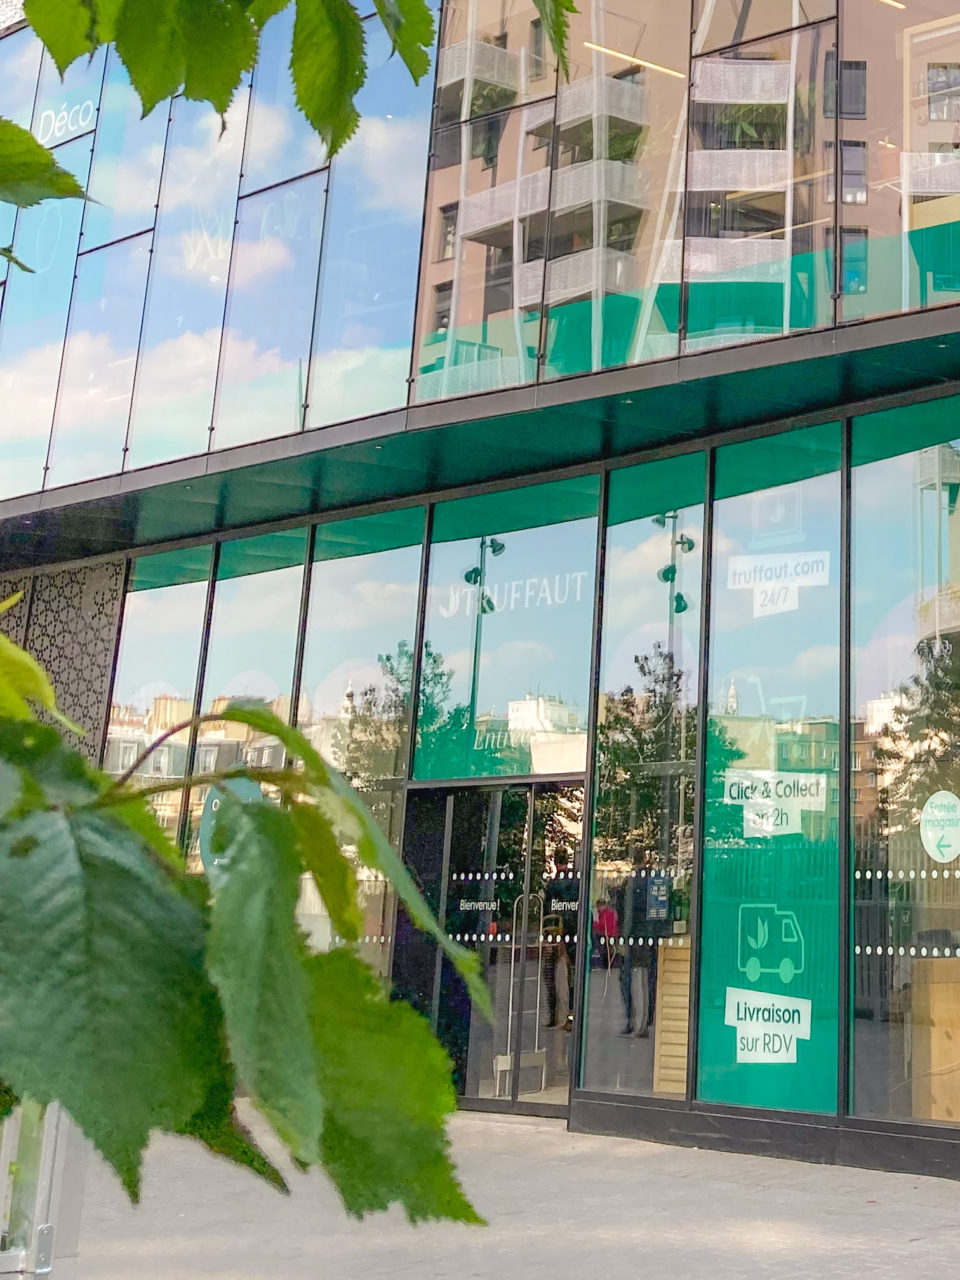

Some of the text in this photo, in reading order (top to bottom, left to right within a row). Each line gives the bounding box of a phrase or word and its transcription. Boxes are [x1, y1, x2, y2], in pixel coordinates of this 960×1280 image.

[38, 99, 94, 144] Déco
[731, 558, 825, 586] truffaut.com
[461, 571, 588, 616] TRUFFAUT
[759, 586, 790, 608] 24/7
[728, 778, 821, 800] Click & Collect
[772, 807, 789, 827] 2h
[736, 1000, 801, 1025] Livraison
[739, 1032, 794, 1054] sur RDV
